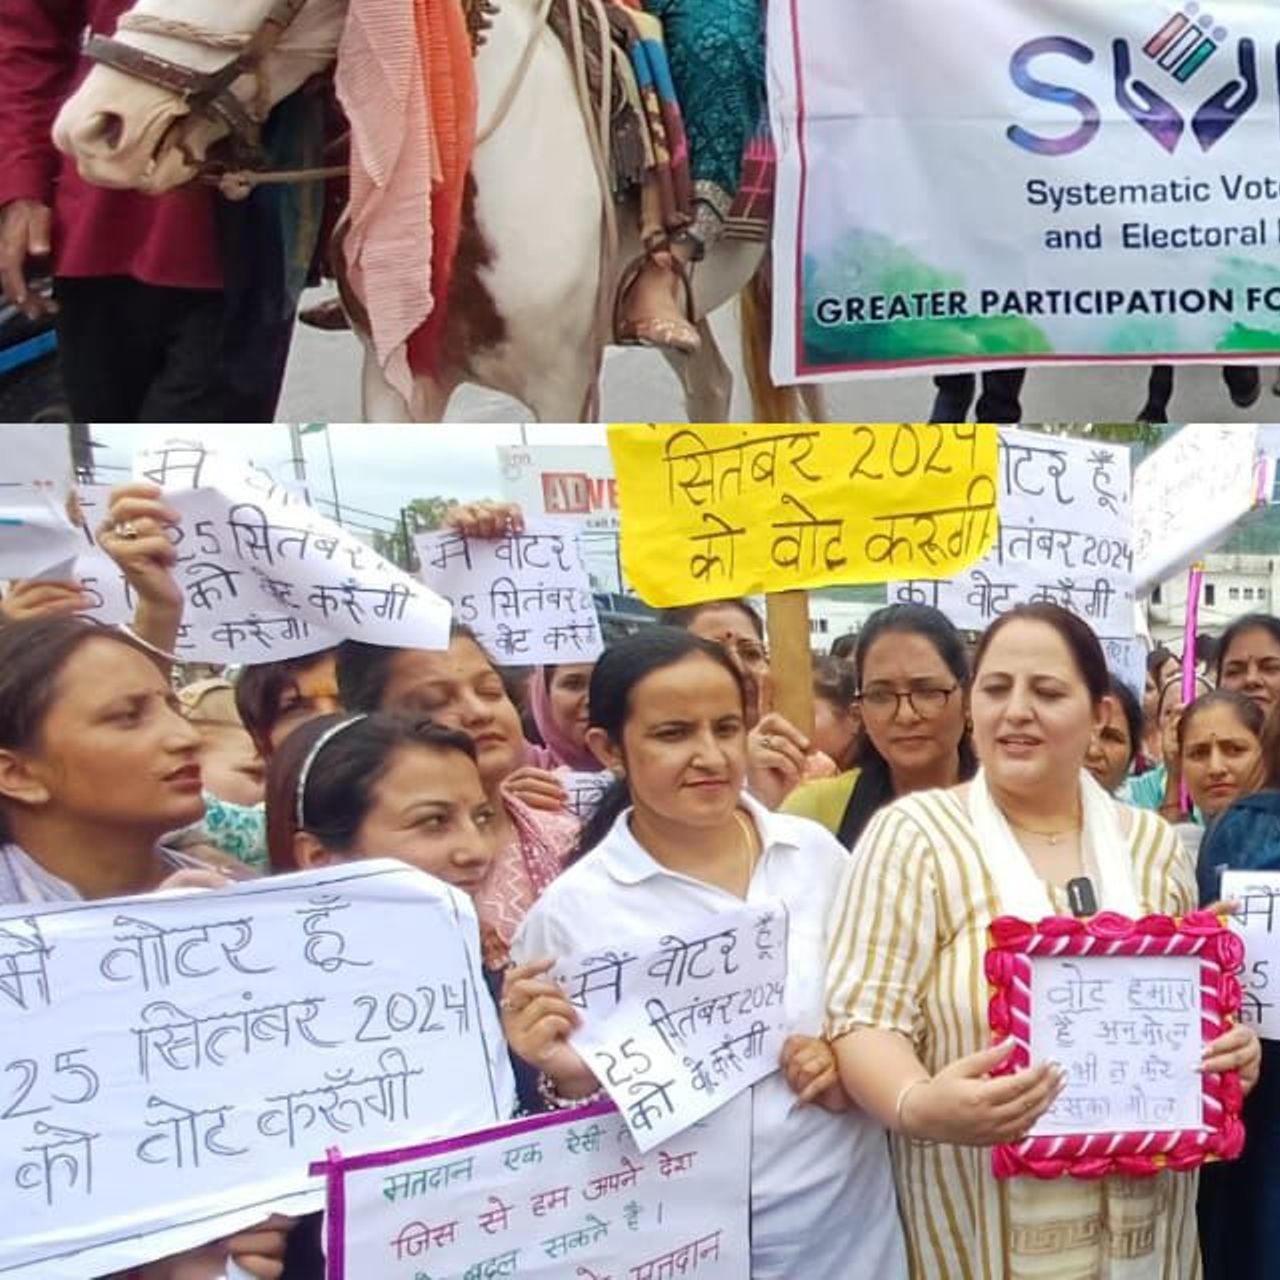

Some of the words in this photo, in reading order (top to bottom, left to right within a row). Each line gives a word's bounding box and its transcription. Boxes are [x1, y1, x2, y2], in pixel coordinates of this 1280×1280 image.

[1027, 176, 1211, 213] Systematic
[1045, 223, 1101, 249] and
[1122, 219, 1266, 249] Electoral
[816, 292, 968, 324] GREATER
[980, 287, 1233, 316] PARTICIPATION
[849, 425, 977, 480] 2024
[690, 512, 746, 582] को
[771, 494, 848, 571] वोट
[1082, 536, 1134, 573] 2024
[99, 916, 277, 992] वोटर
[648, 928, 739, 986] वोटर
[1048, 962, 1113, 1009] वोट
[2, 1049, 100, 1118] 25
[131, 992, 346, 1083] सितंबर
[353, 978, 471, 1043] 2024
[596, 1038, 652, 1086] 25
[739, 984, 785, 1015] 2024
[628, 1079, 676, 1130] को
[15, 1121, 101, 1206] को
[137, 1097, 249, 1167] वोट
[503, 1140, 544, 1171] एक
[390, 1221, 459, 1261] जिस
[478, 1195, 514, 1235] से
[530, 1186, 571, 1218] हम
[582, 1156, 646, 1202] अपने
